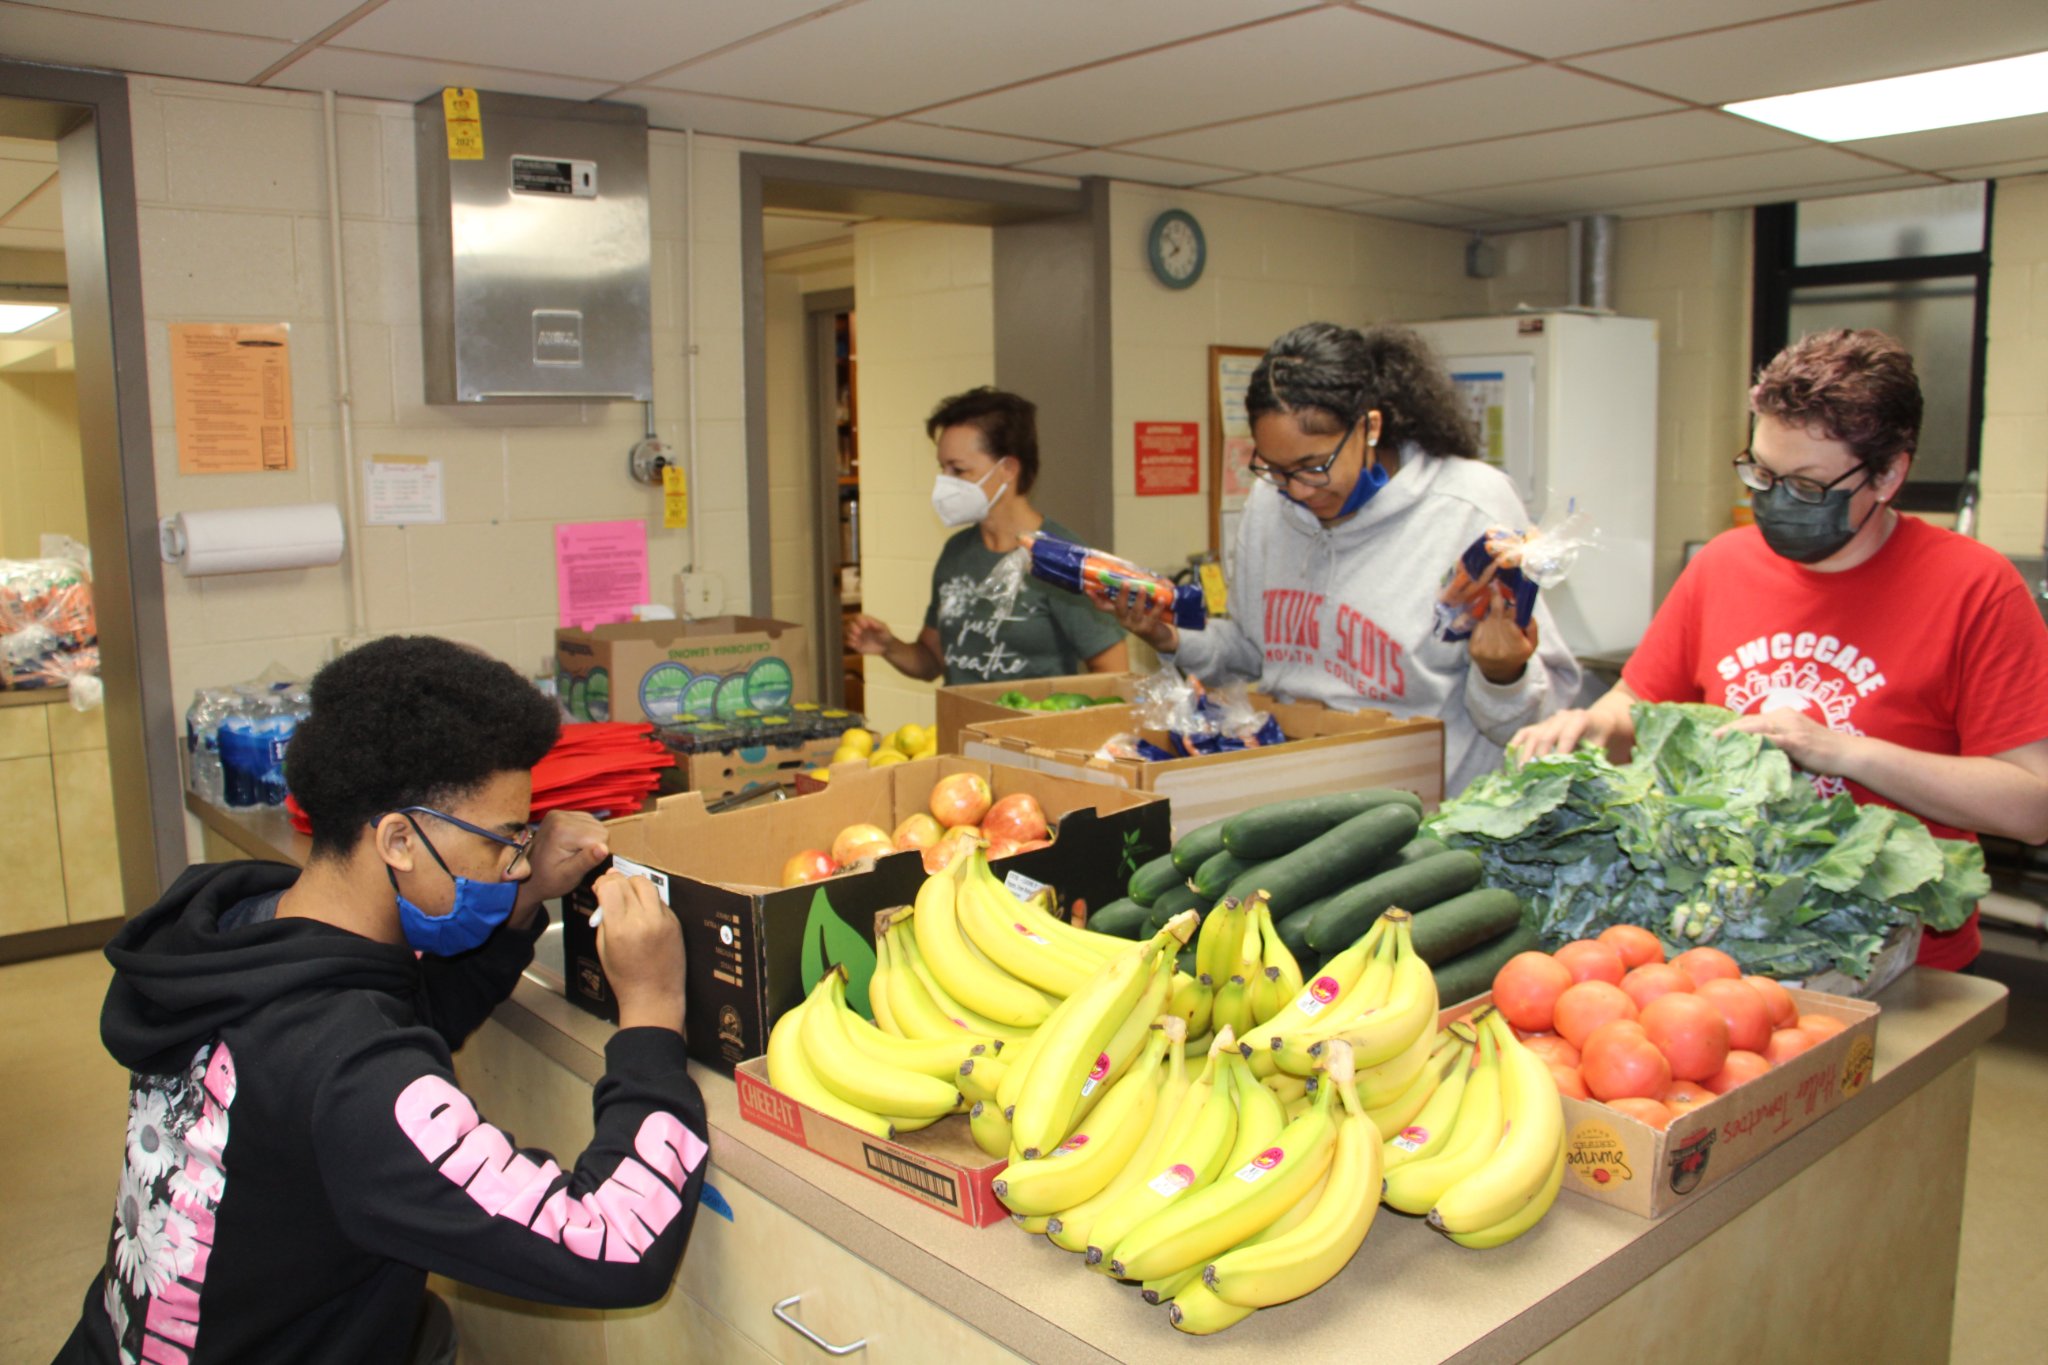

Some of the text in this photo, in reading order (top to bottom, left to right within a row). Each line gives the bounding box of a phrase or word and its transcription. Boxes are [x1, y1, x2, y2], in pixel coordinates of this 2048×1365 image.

[957, 616, 1027, 647] just
[1336, 602, 1405, 698] SCOTS
[668, 647, 710, 660] LEMONS
[1716, 631, 1888, 698] SWCCCASE
[1324, 659, 1389, 702] COLLEGE
[740, 1078, 794, 1129] CHEEZ-IT
[1567, 1147, 1633, 1181] Sunripe
